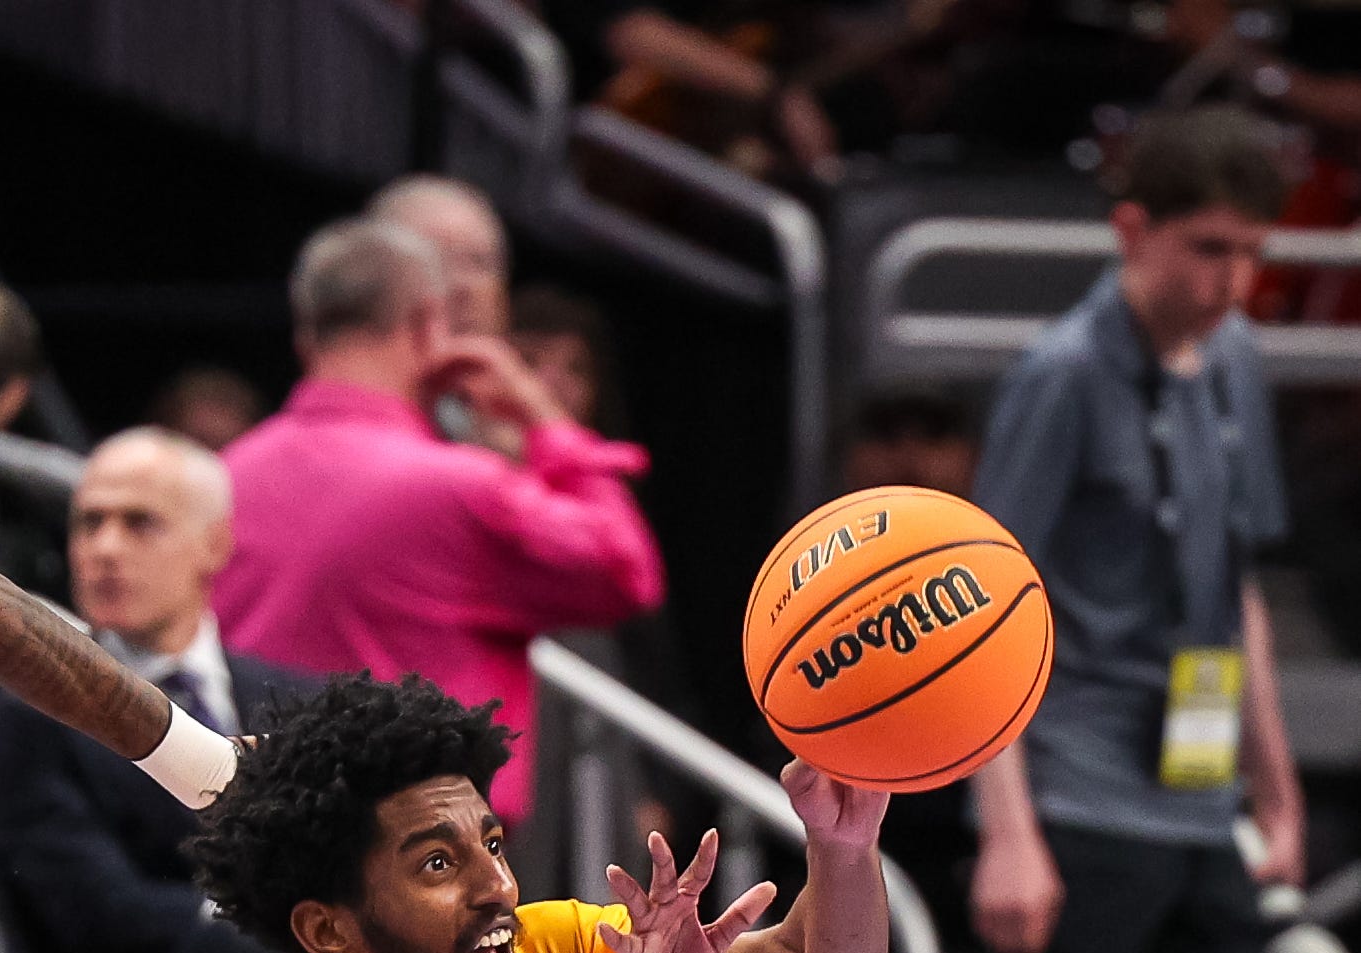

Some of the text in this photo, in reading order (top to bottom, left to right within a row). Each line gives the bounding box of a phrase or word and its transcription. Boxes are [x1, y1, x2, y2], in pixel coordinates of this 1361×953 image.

[789, 509, 891, 594] EVO
[769, 588, 793, 628] NXT
[796, 560, 992, 690] Wilson
